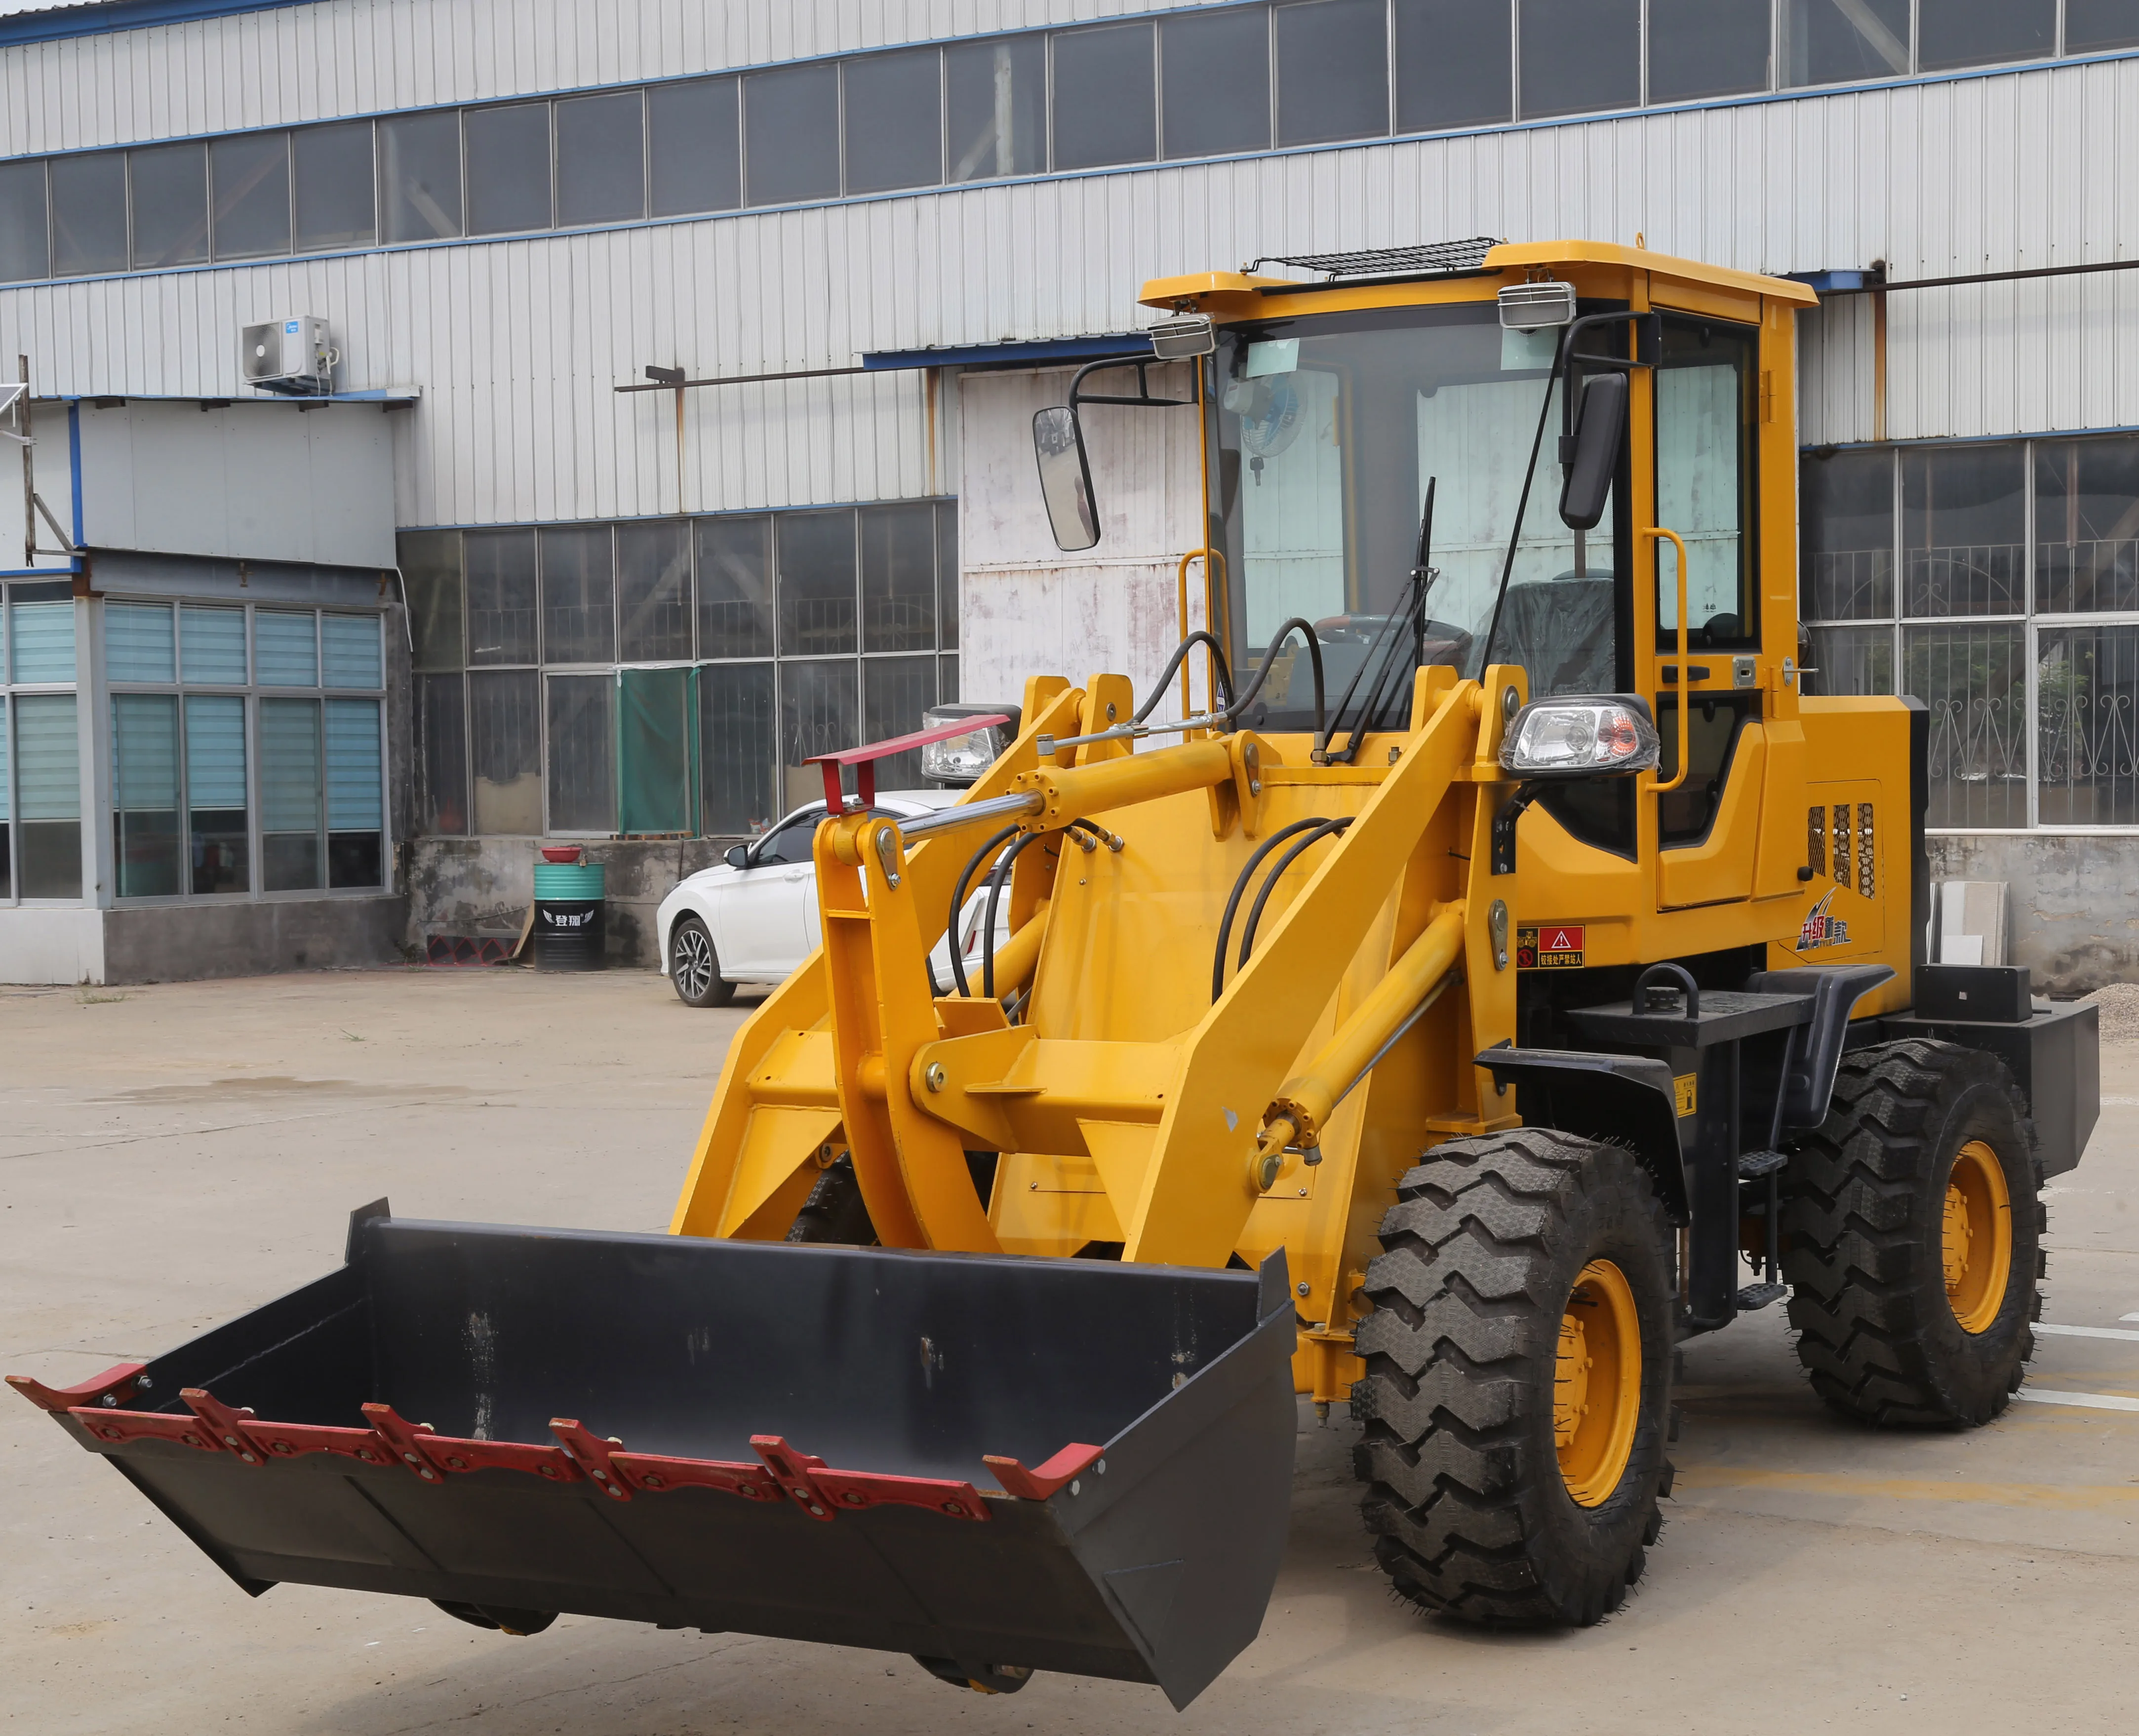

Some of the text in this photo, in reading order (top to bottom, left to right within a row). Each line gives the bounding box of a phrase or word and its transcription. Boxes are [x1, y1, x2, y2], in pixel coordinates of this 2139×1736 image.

[555, 915, 580, 926] 登翔
[1803, 916, 1851, 945] 升级新款
[1541, 954, 1581, 965] 铰接处严禁站人
